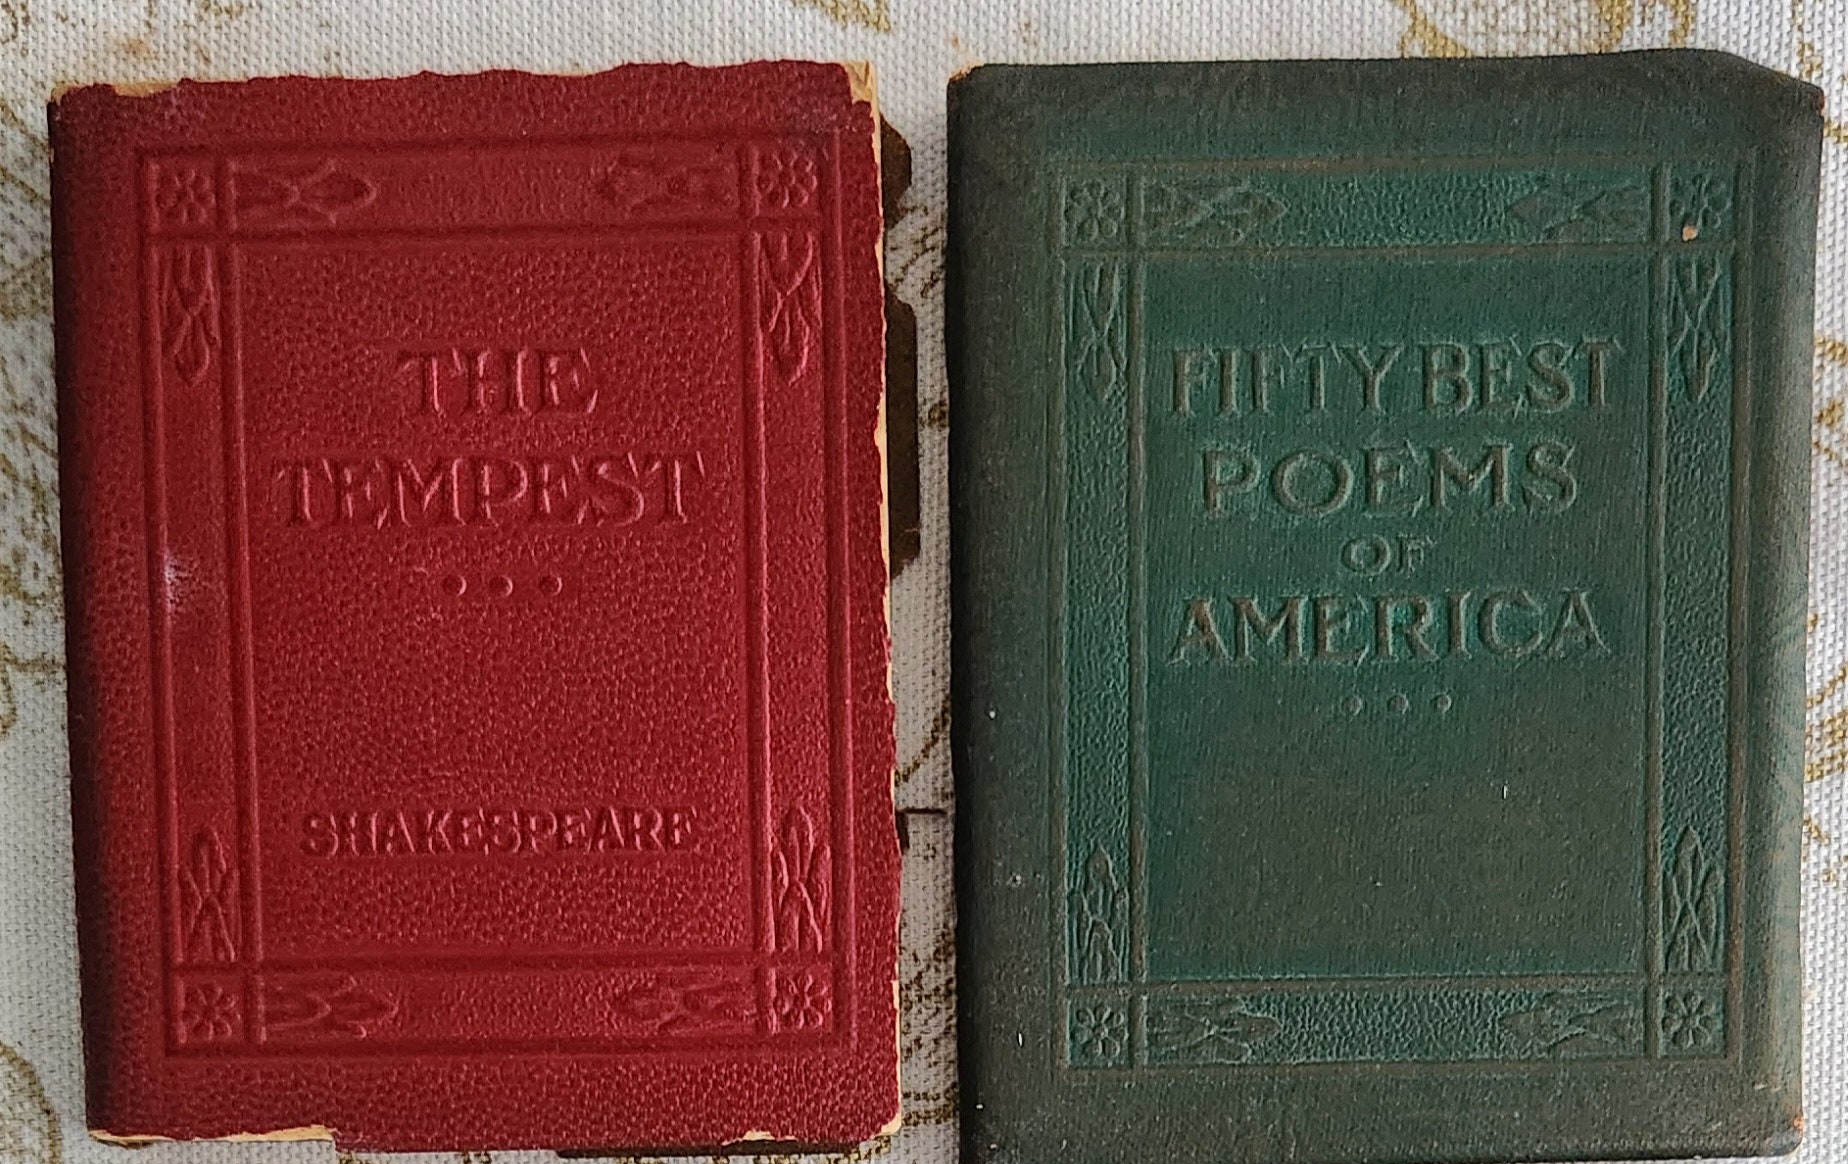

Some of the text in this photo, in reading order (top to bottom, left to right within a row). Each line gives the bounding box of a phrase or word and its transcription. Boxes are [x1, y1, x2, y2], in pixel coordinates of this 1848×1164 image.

[400, 346, 600, 414] THE
[1169, 335, 1624, 418] FIFTY BEST
[272, 450, 706, 528] TEMPEST
[1200, 438, 1580, 518] POEMS
[1341, 533, 1436, 577] OF
[1167, 588, 1612, 668] AMERICA
[303, 804, 698, 856] SHAKESPEARE
